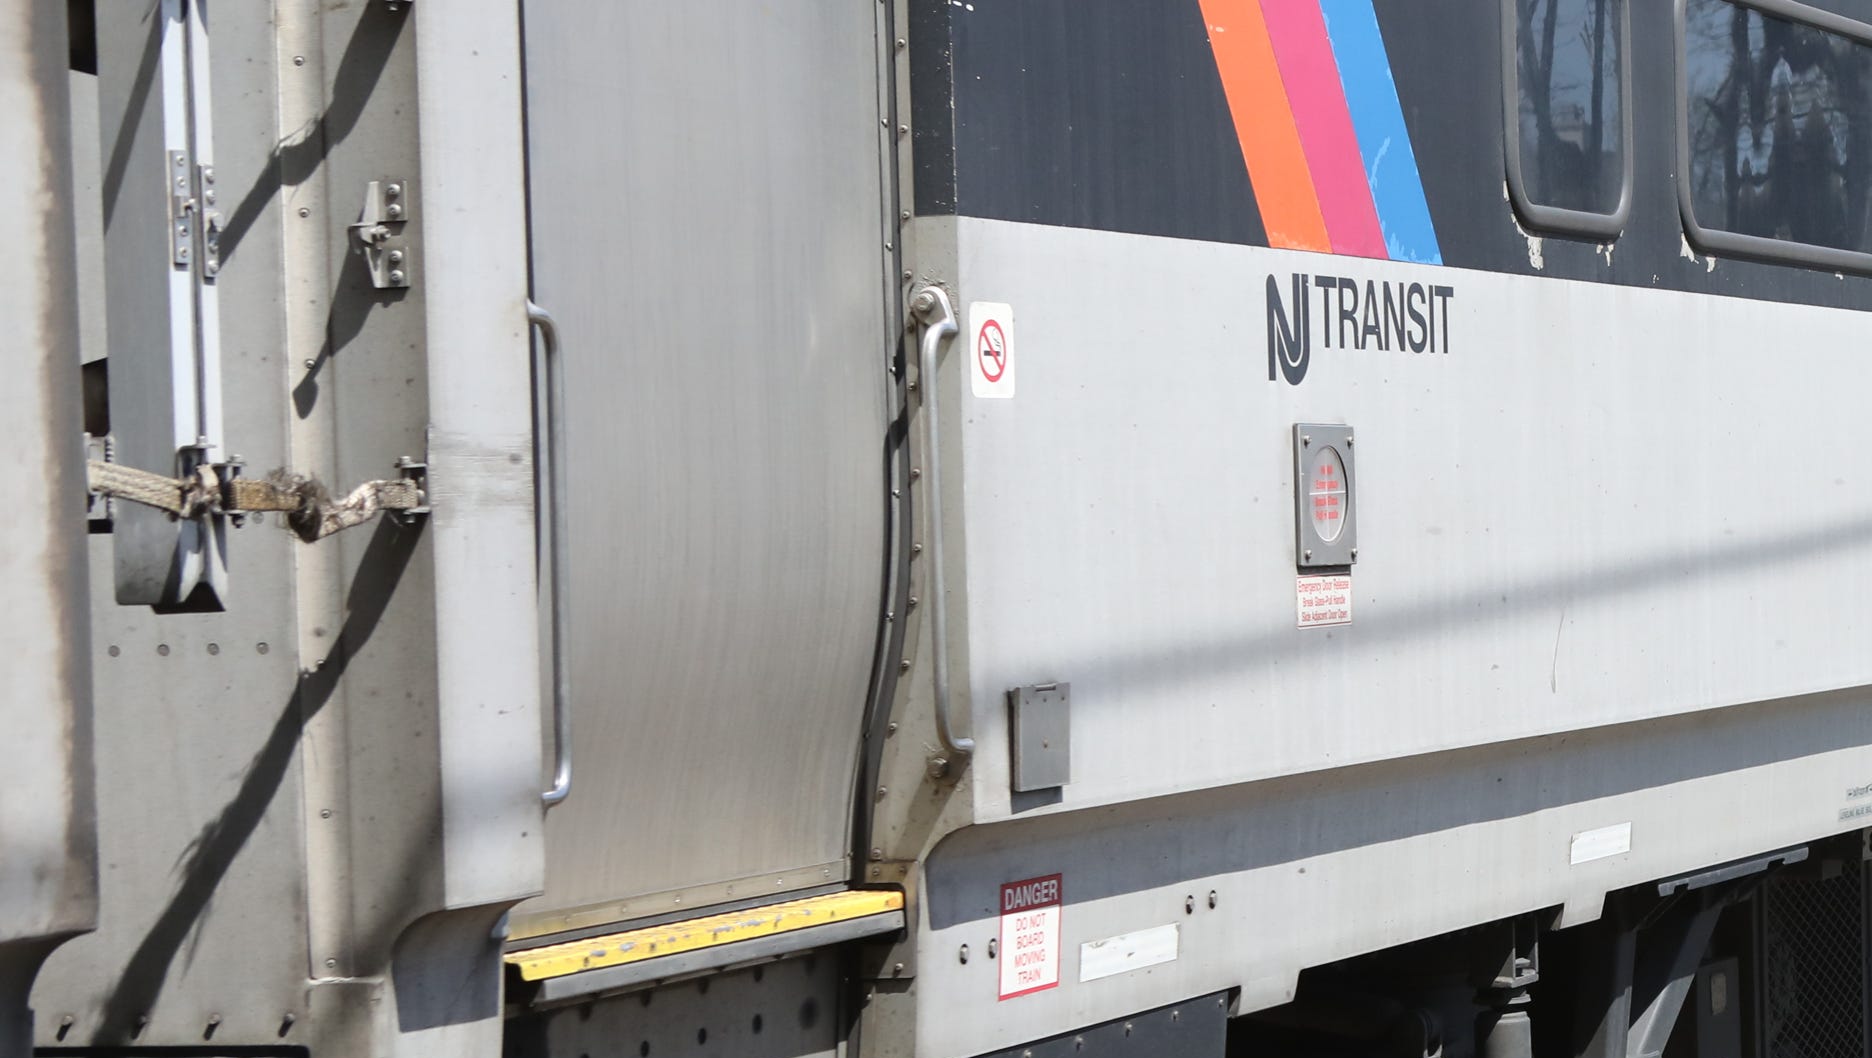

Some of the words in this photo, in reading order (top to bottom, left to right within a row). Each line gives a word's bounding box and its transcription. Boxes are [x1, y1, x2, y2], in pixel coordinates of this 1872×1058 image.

[1315, 275, 1454, 354] TRANSIT
[1005, 880, 1058, 911] DANGER
[1016, 916, 1028, 931] DO
[1029, 912, 1046, 928] NOT
[1017, 931, 1045, 950] BOARD
[1014, 948, 1045, 968] MOVING
[1018, 968, 1041, 984] TRAIN
